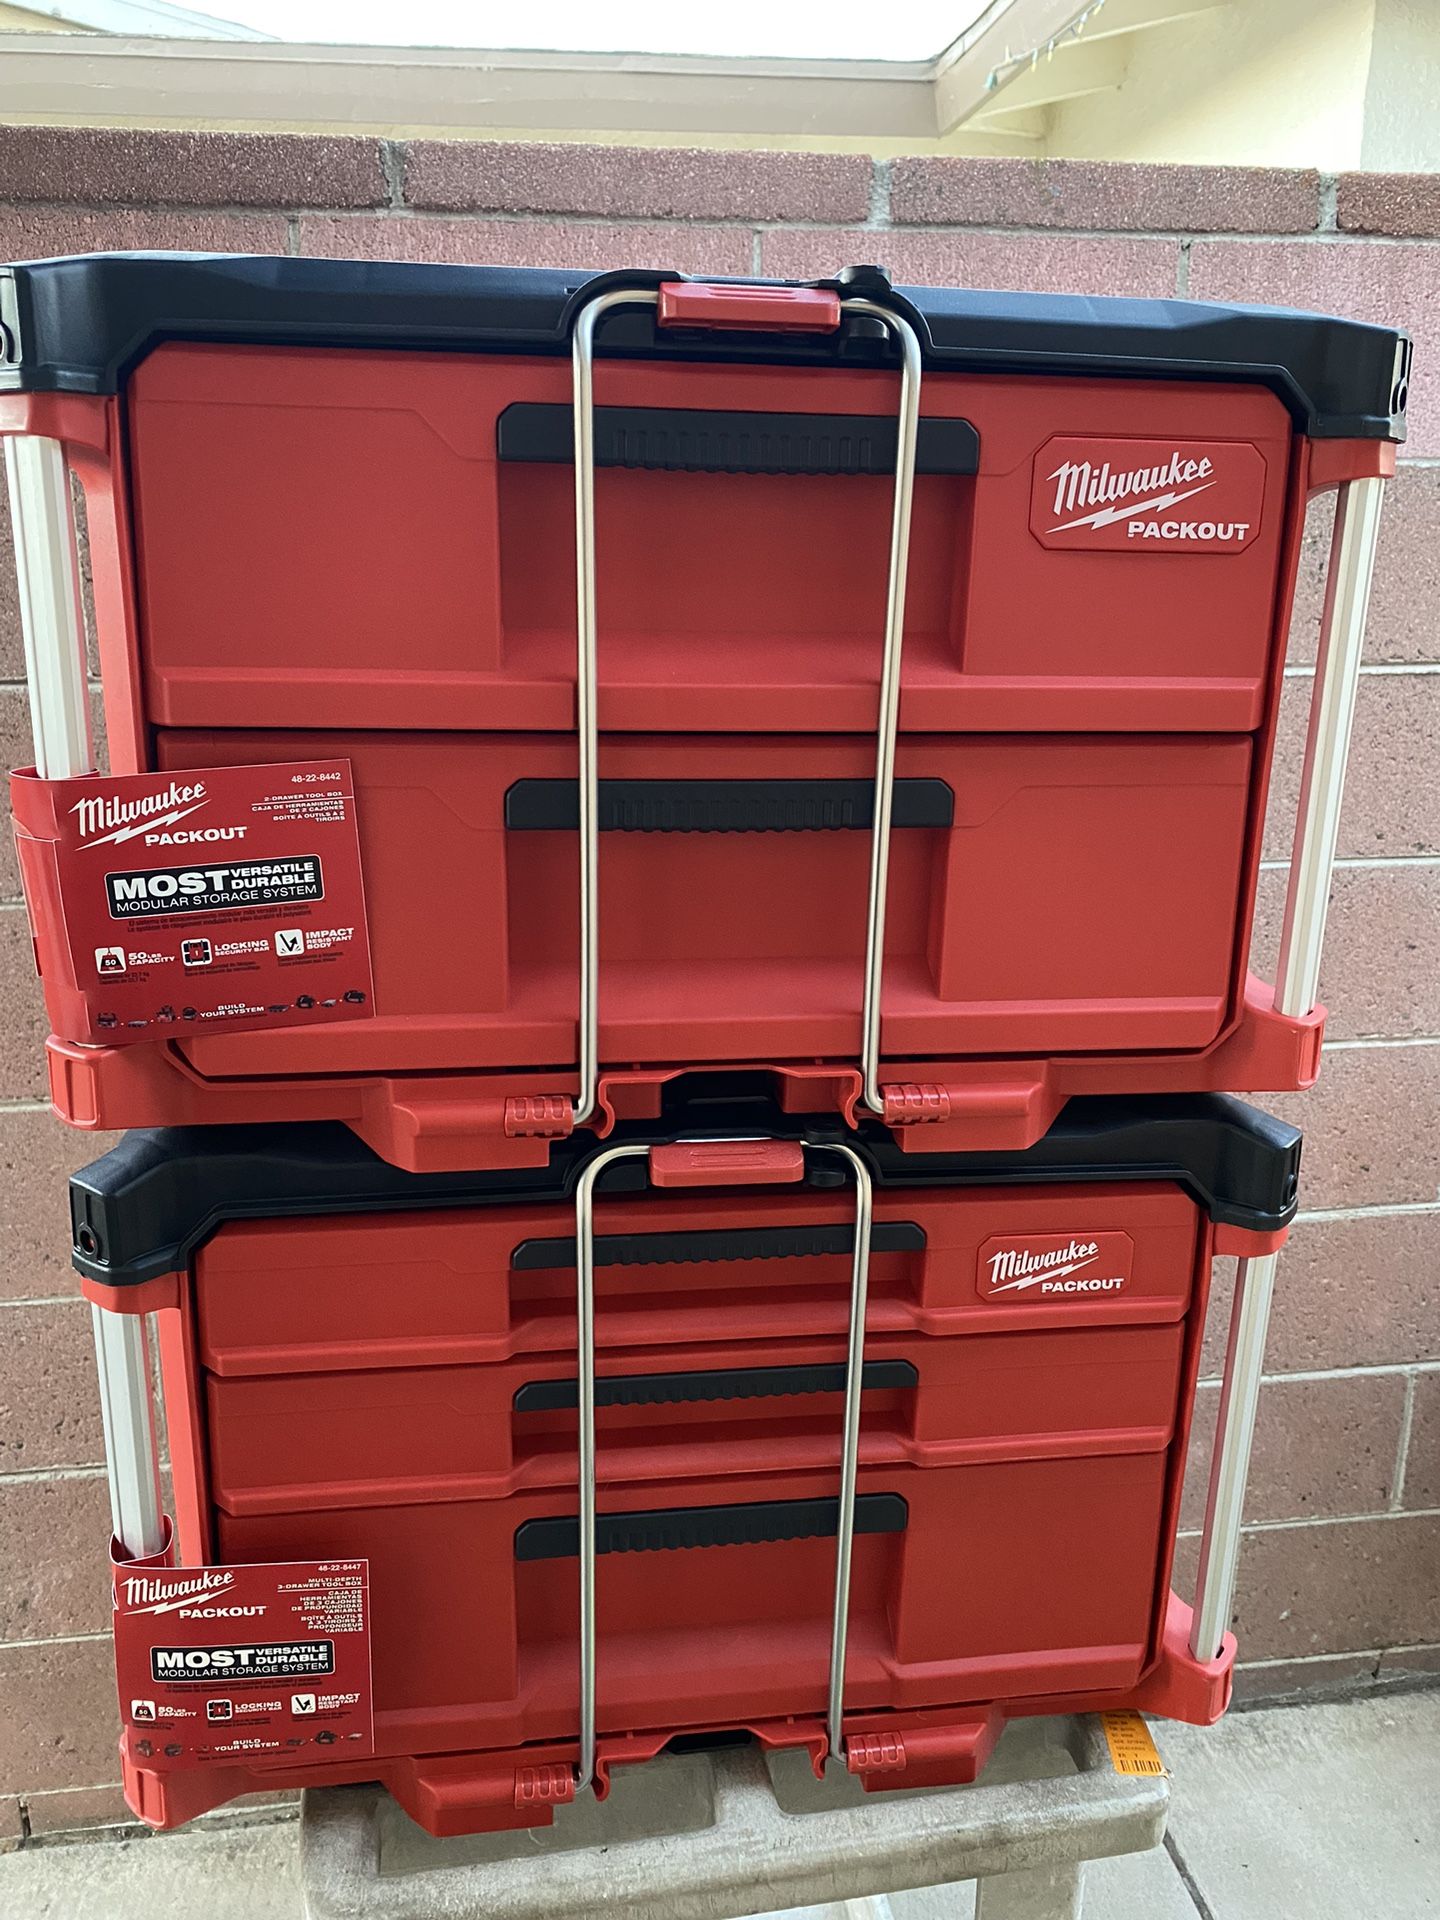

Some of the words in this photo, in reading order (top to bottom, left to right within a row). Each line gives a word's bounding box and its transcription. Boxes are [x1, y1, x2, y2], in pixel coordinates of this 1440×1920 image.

[1046, 452, 1214, 516] Milwaukee
[1127, 521, 1249, 540] PACKOUT
[291, 772, 341, 783] 48-22-8442
[264, 794, 304, 802] 2-DRAWER
[68, 782, 207, 837] Milwaukee
[285, 800, 344, 809] HERRAMIENTAS
[145, 826, 247, 846] PACKOUT
[113, 870, 230, 900] MOST
[231, 861, 314, 877] VERSATILE
[231, 872, 316, 890] DURABLE
[116, 897, 189, 912] MODULAR
[192, 890, 259, 906] STORAGE
[263, 884, 317, 898] SYSTEM
[305, 928, 354, 939] IMPACT
[306, 935, 353, 944] RESISTANT
[214, 939, 269, 951] LOCKING
[307, 942, 332, 950] BODY
[128, 952, 147, 960] 50
[215, 948, 252, 956] SECURITY
[129, 956, 175, 966] CAPACITY
[200, 1010, 226, 1018] YOUR
[227, 1006, 265, 1015] SYSTEM
[217, 1003, 246, 1011] BUILD
[986, 1240, 1099, 1284] Milwaukee
[1041, 1278, 1124, 1293] PACKOUT
[120, 1571, 235, 1606] Milwaukee
[179, 1605, 267, 1619] PACKOUT
[304, 1603, 363, 1611] PROFUNDIDAD
[156, 1650, 255, 1669] MOST
[255, 1645, 328, 1656] VERSATILE
[255, 1653, 328, 1665] DURABLE
[158, 1669, 219, 1677] MODULAR
[222, 1665, 279, 1675] STORAGE
[282, 1662, 329, 1672] SYSTEM
[318, 1693, 361, 1701] IMPACT
[235, 1701, 282, 1710] LOCKING
[242, 1741, 280, 1749] SYSTEM
